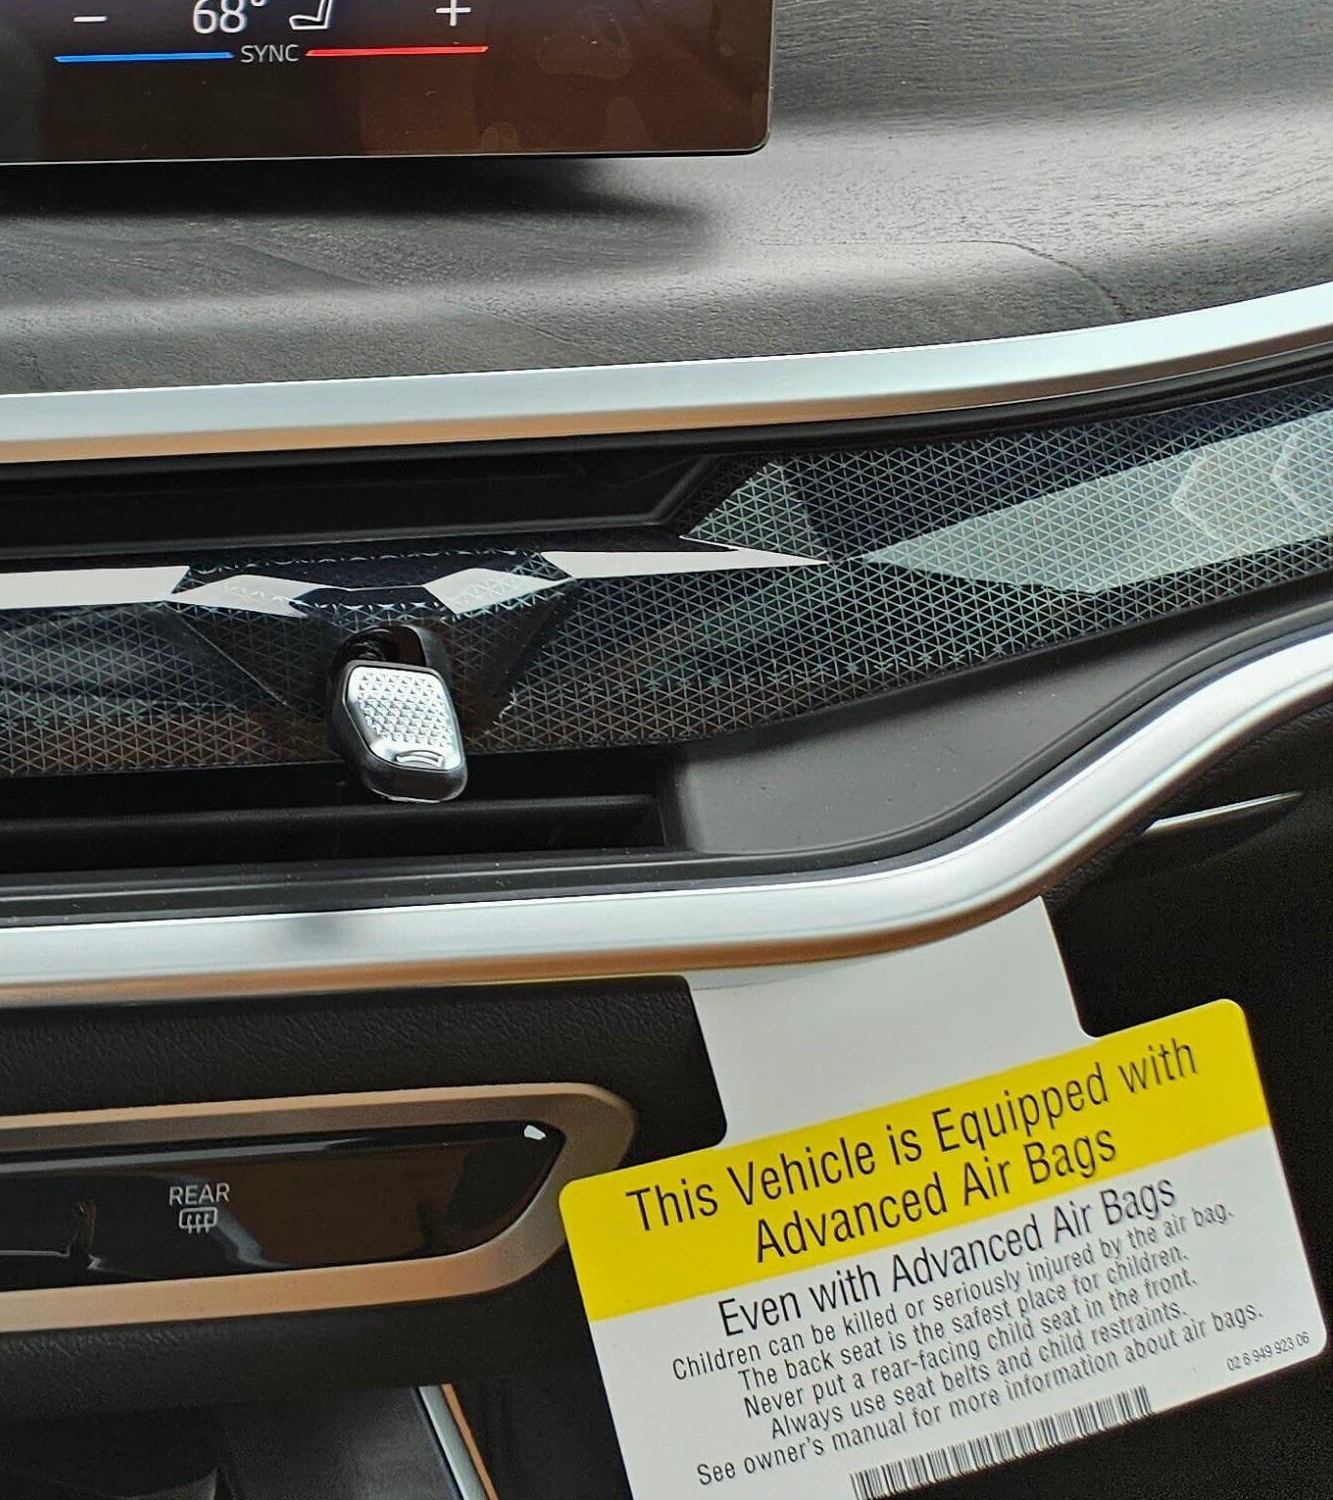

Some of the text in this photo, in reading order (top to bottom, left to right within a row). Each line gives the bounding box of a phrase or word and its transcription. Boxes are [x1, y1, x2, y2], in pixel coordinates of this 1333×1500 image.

[240, 44, 299, 64] SYNC
[169, 1183, 230, 1207] REAR
[625, 1037, 1198, 1231] This Vehicle is Equipped with
[756, 1129, 1117, 1263] Advanced Air Bags
[672, 1202, 1235, 1381] Children can be killed or seriously injured by the air bag.
[717, 1179, 1176, 1337] Even with Advanced Air Bags
[738, 1243, 1190, 1391] The back seat is the safest place for children.
[696, 1302, 1265, 1486] See owner's manual for more information about air bags.
[743, 1267, 1198, 1419] Never put a rear-facing child seat in the front.
[771, 1300, 1188, 1440] Always use seat belts and child restraints.
[1226, 1355, 1243, 1372] 02
